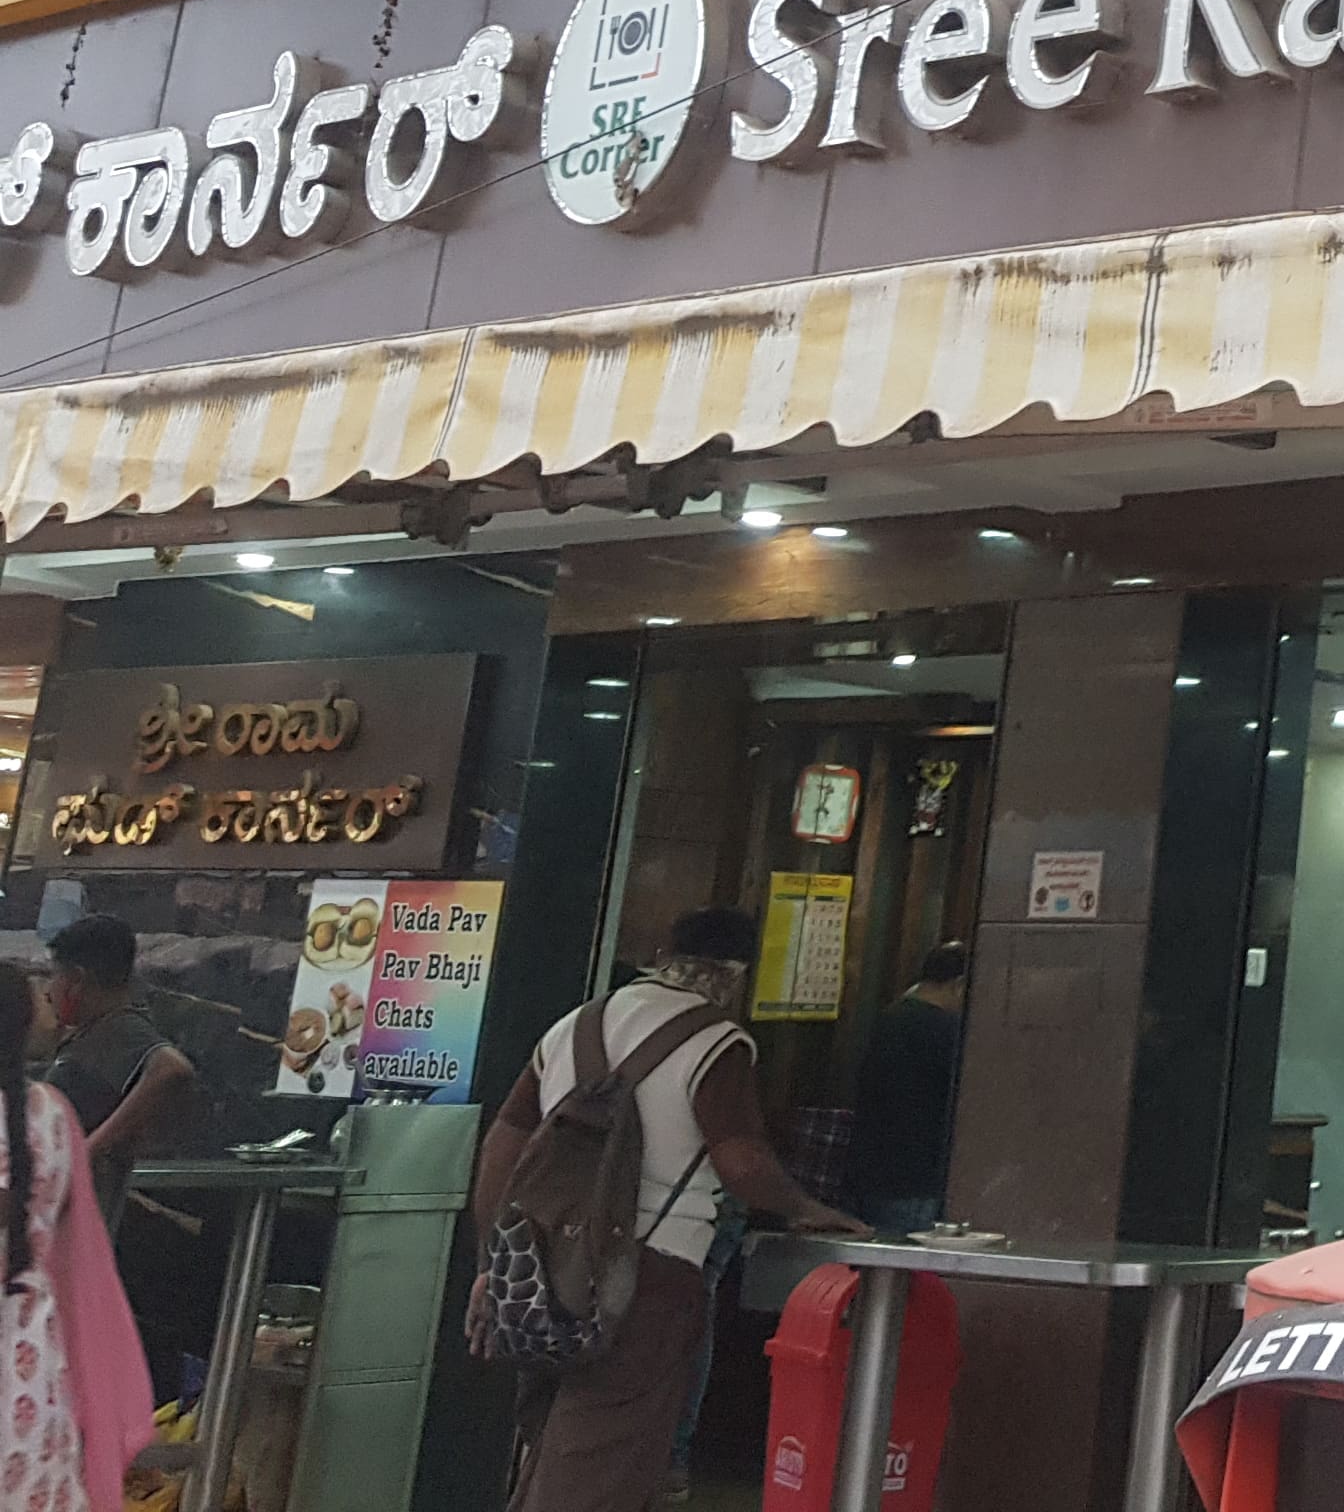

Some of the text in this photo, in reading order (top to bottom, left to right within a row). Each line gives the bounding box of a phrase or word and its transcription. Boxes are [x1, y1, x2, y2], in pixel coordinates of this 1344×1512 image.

[392, 903, 487, 932] Vada Pav
[381, 953, 483, 989] Pav Bhaji
[374, 1000, 435, 1029] Chats
[365, 1050, 459, 1081] available
